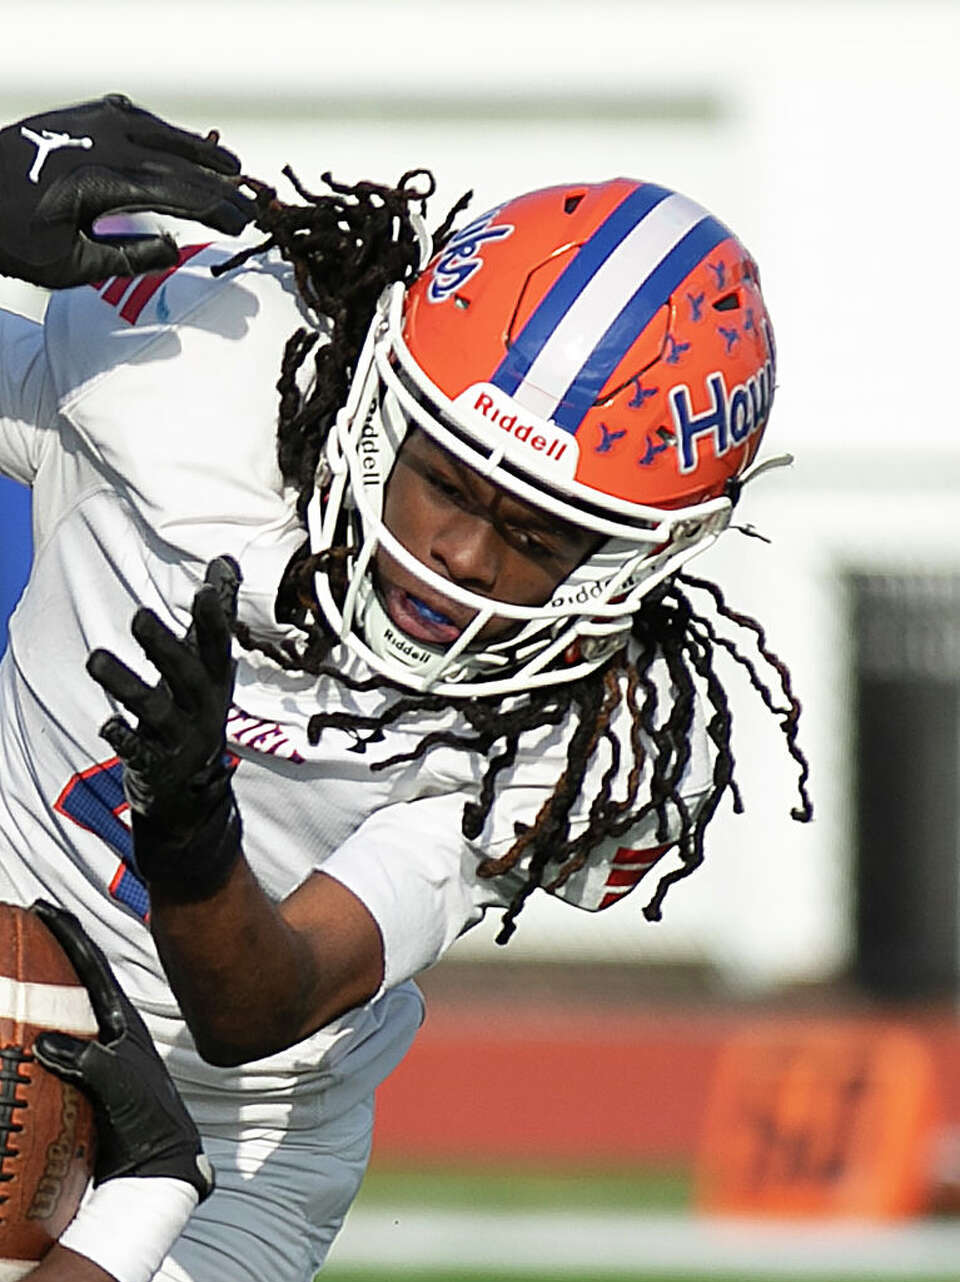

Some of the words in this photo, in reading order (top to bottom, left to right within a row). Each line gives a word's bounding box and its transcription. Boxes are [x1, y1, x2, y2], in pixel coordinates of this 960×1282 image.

[473, 392, 568, 461] Riddell
[669, 320, 777, 473] Haw
[384, 628, 431, 663] Riddell
